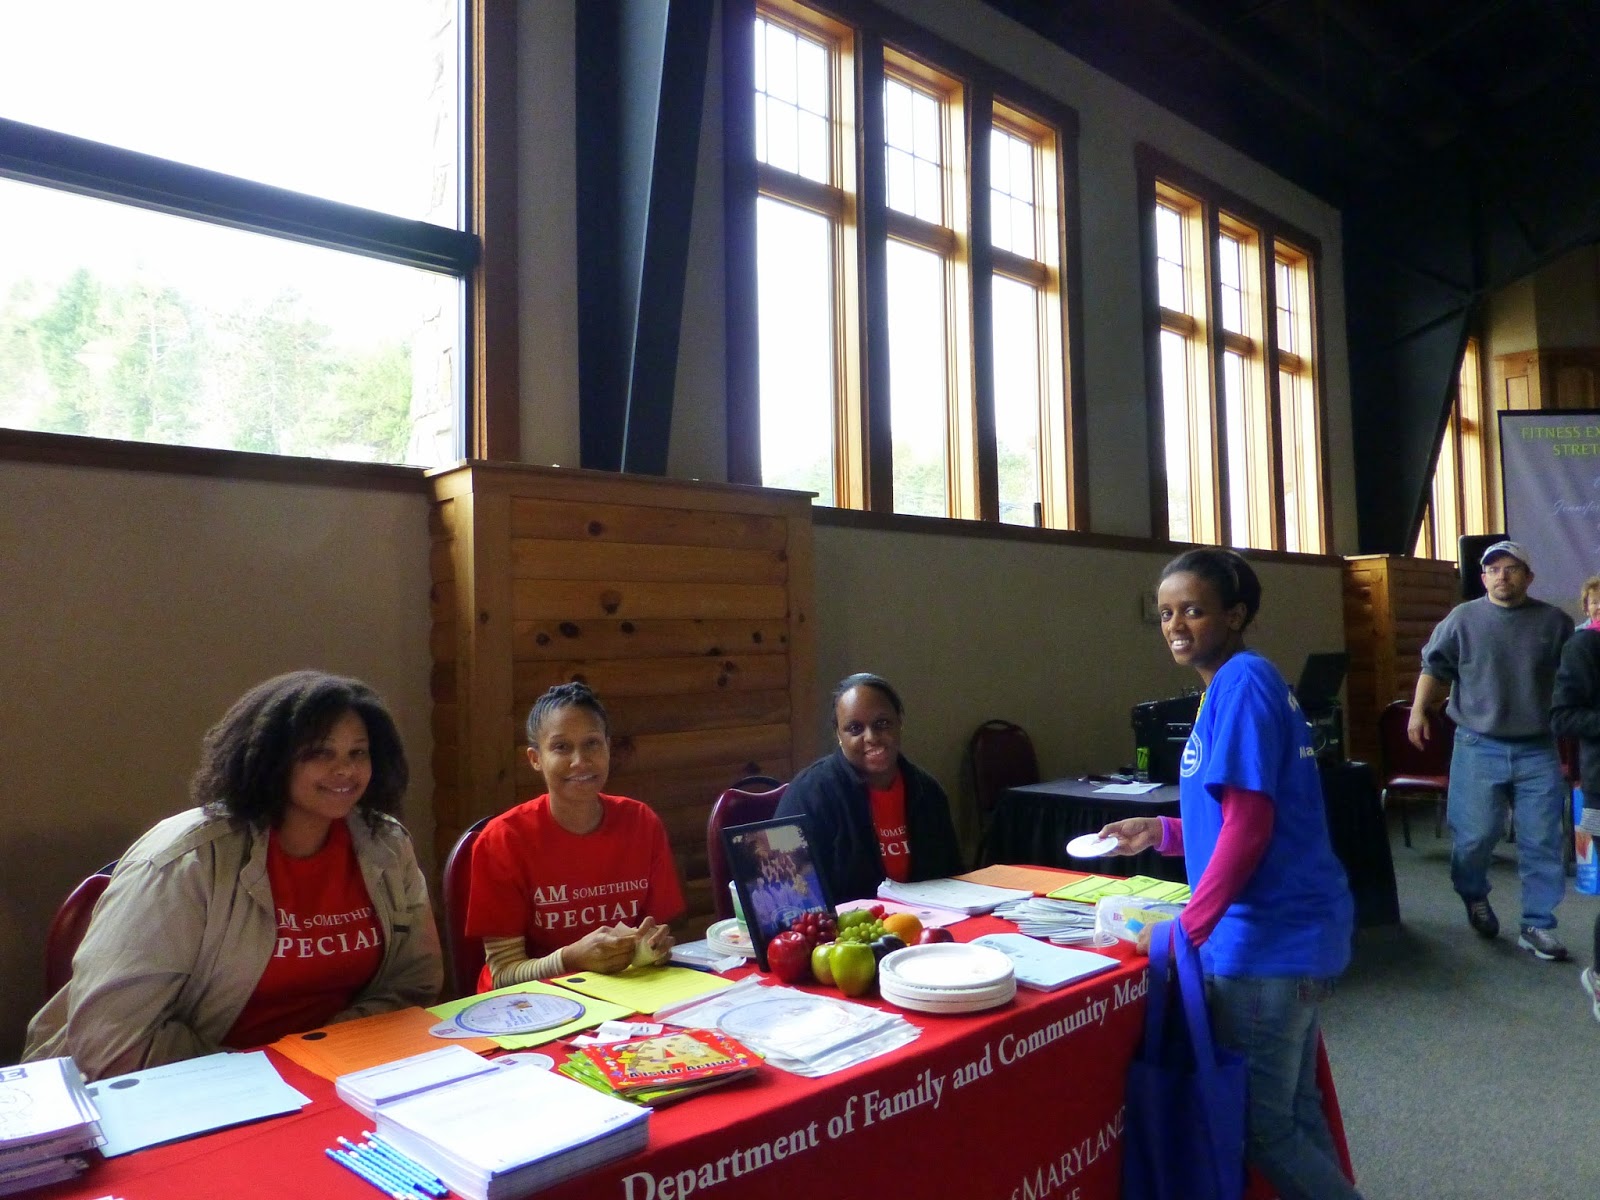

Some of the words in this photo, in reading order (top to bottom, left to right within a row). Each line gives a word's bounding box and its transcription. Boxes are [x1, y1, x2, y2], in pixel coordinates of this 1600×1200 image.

[1521, 427, 1581, 439] FITNESS
[534, 884, 569, 905] AM
[572, 879, 649, 900] SOMETHING
[277, 908, 301, 931] M
[273, 928, 381, 958] PECIAL
[621, 1121, 820, 1200] Department
[827, 1096, 858, 1139] of
[863, 1068, 946, 1127] Family
[953, 1043, 994, 1089] and
[998, 996, 1109, 1066] Community
